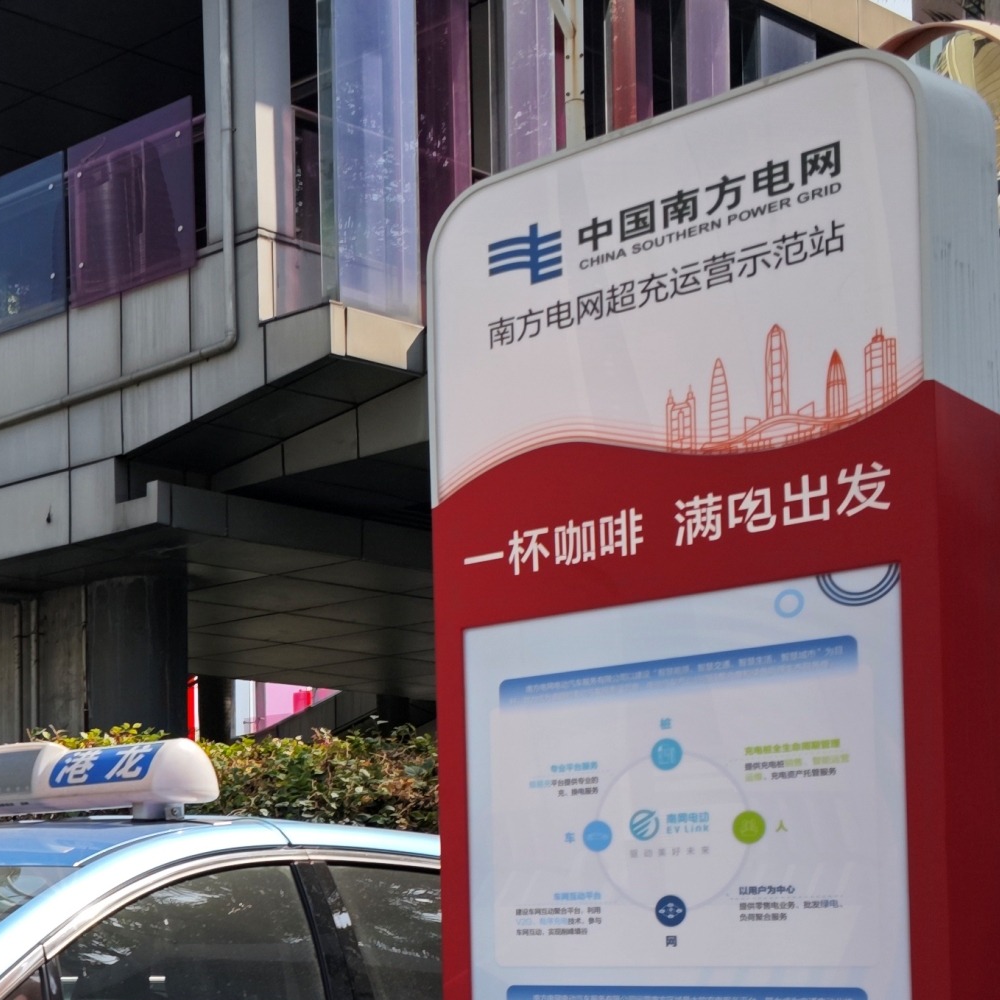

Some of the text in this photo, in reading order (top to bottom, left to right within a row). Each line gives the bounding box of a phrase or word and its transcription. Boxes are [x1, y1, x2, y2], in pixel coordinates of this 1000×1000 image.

[578, 140, 841, 252] 中国南方电网
[579, 182, 842, 270] CHINA SOUTHERN POWER GRID
[488, 220, 845, 349] 南方电网超充运营示范站
[463, 461, 891, 576] 一杯咖啡 满电出发
[55, 744, 154, 785] 港龙
[776, 820, 788, 832] 人
[739, 885, 795, 895] 以用户为中心
[666, 936, 677, 947] 网
